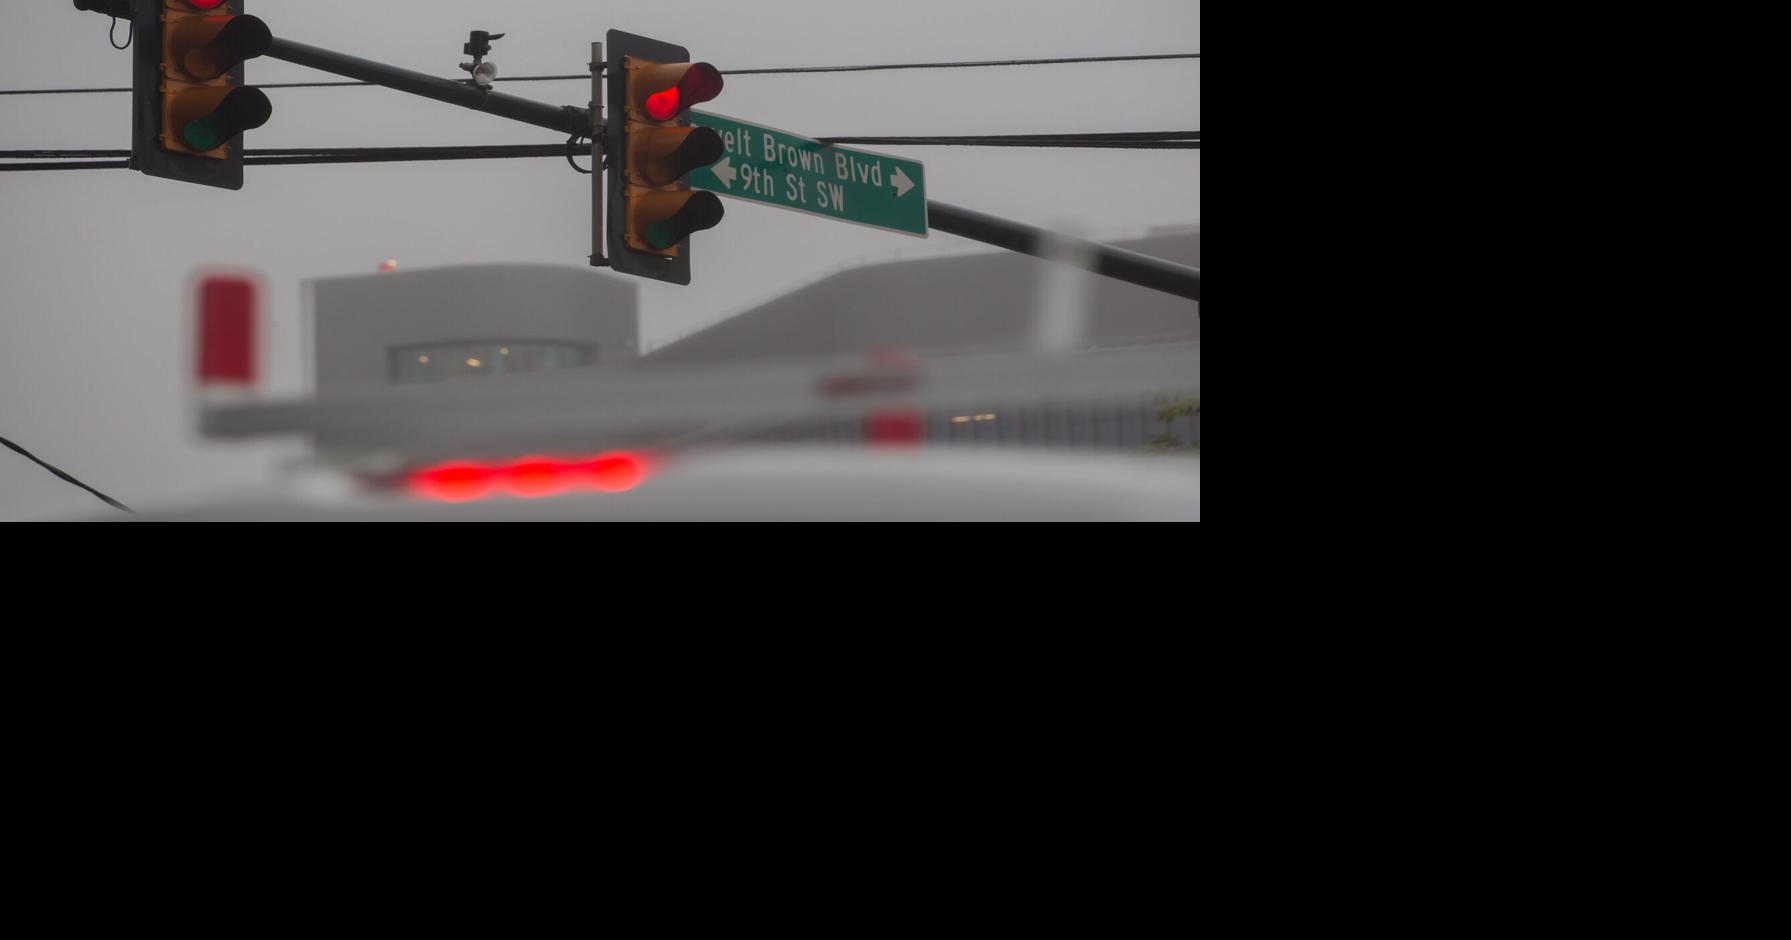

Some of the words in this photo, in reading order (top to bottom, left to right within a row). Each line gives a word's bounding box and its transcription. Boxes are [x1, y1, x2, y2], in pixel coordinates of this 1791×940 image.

[763, 133, 824, 175] Brown
[834, 152, 882, 187] Blvd
[741, 163, 774, 197] 9th
[786, 173, 806, 204] St
[816, 180, 844, 212] SW
